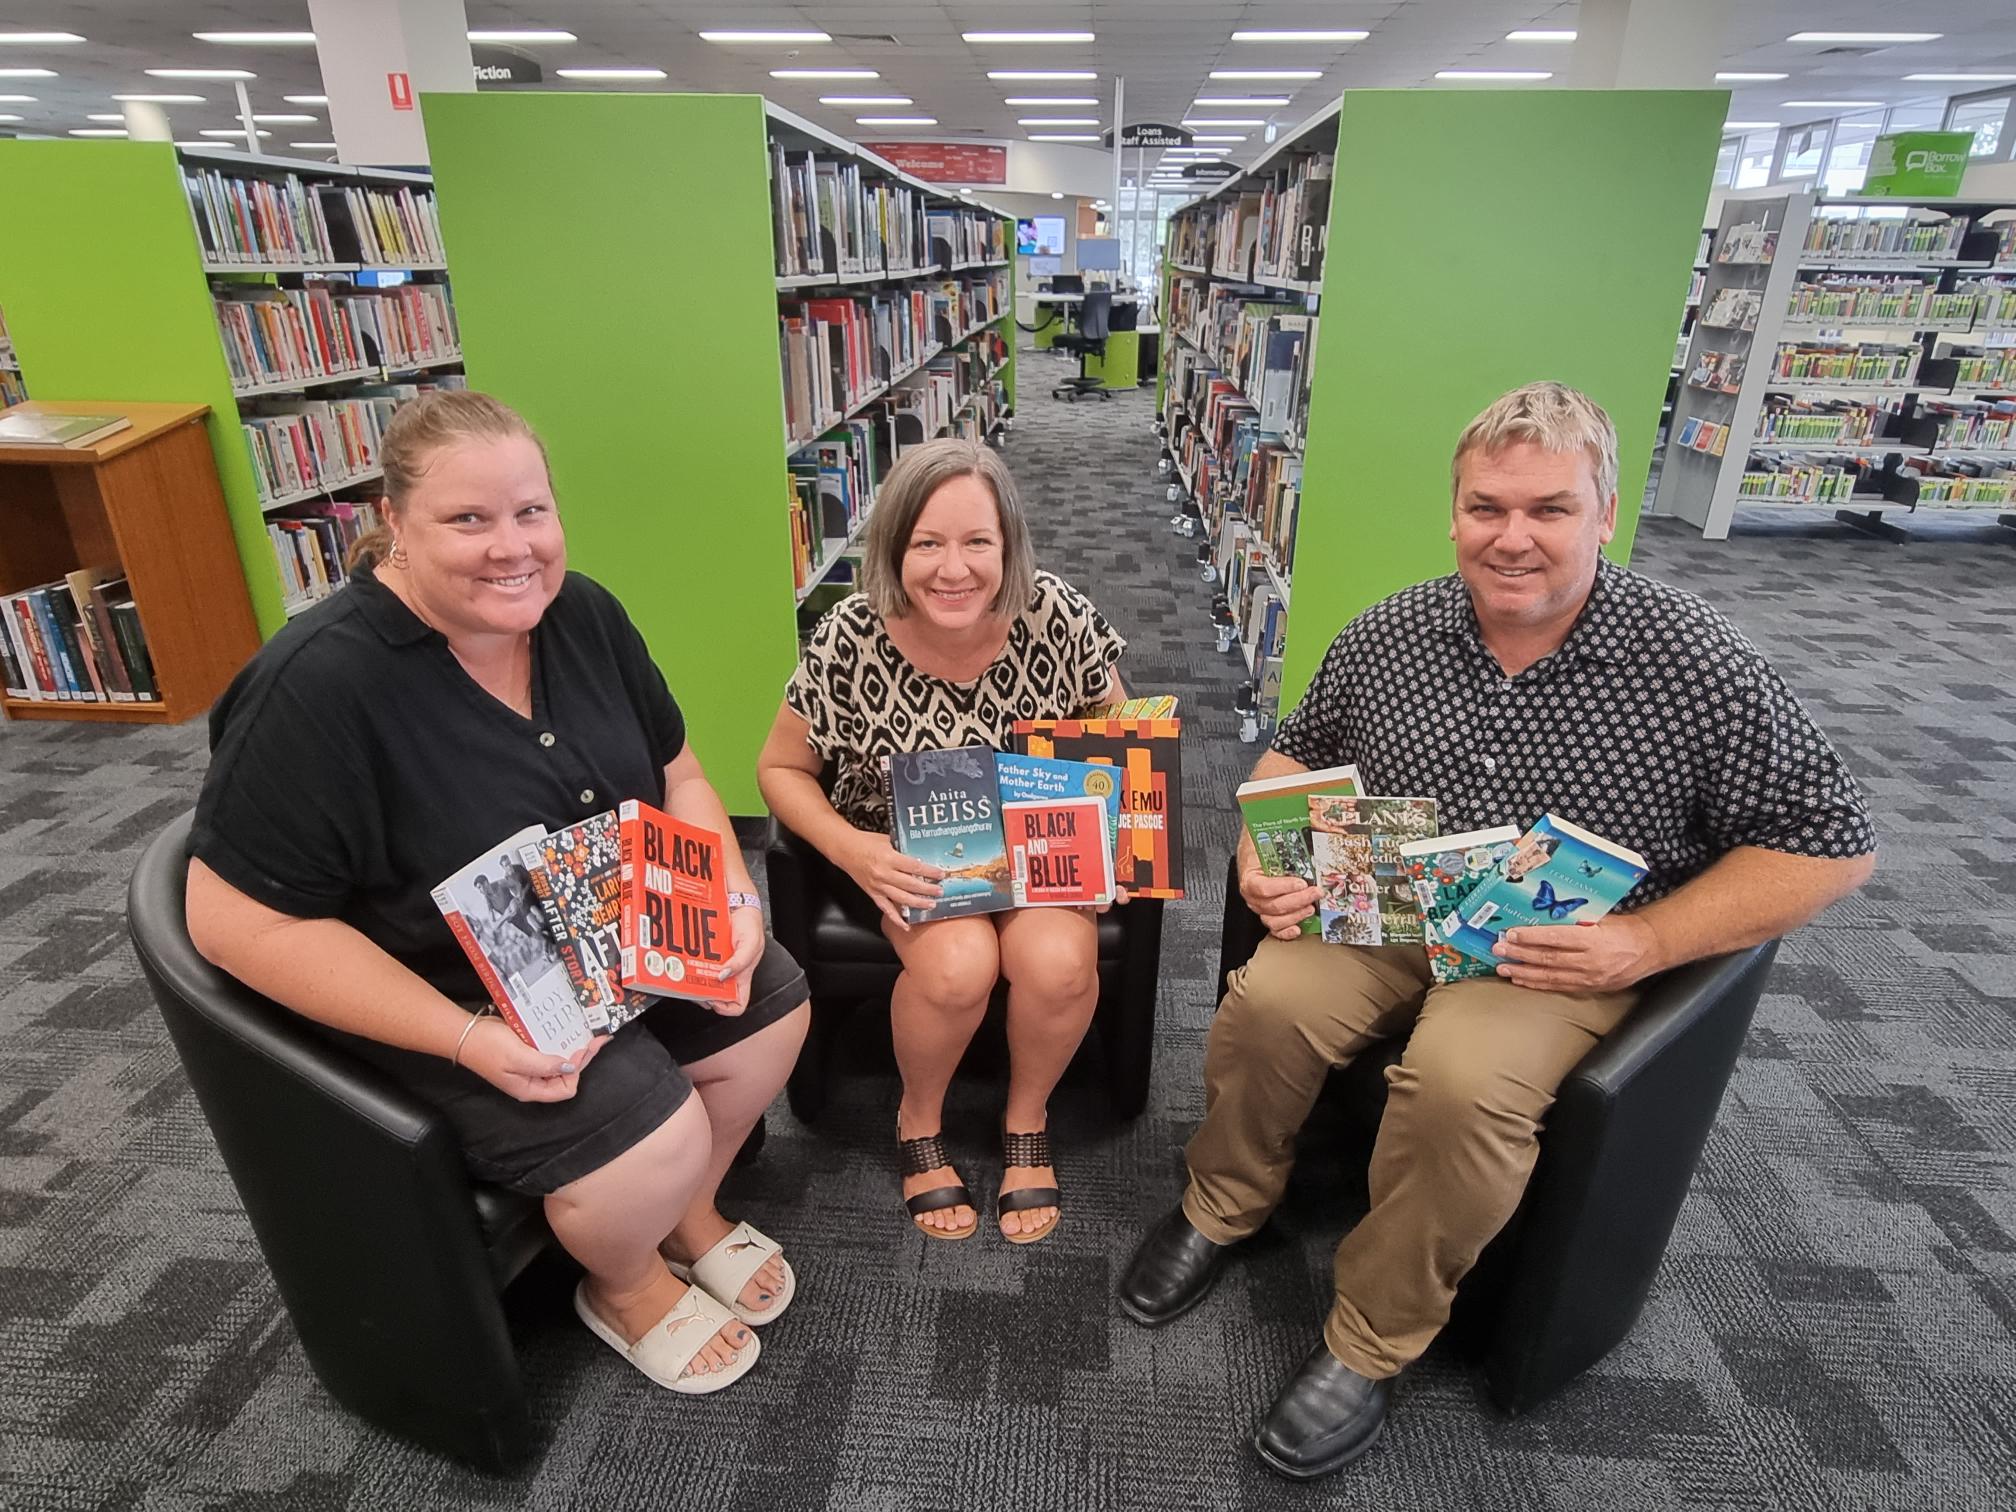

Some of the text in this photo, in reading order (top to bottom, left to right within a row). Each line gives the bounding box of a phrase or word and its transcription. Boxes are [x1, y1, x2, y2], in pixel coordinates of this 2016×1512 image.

[473, 66, 511, 80] Fiction
[1120, 136, 1181, 146] taff Assisted
[1137, 126, 1162, 136] Loans
[895, 159, 944, 169] Welcome
[1928, 151, 1966, 163] Borrow
[998, 763, 1069, 781] Father Sky and
[1000, 775, 1065, 792] Mother Earth
[1093, 780, 1105, 790] 40
[928, 788, 967, 802] Anita
[1131, 790, 1163, 811] EMU
[907, 798, 991, 827] HEISS
[1134, 813, 1163, 830] PASCOE
[1341, 810, 1428, 827] PLANTS
[1024, 812, 1077, 838] BLACK
[644, 820, 713, 881] BLACK
[1027, 838, 1048, 855] AND
[1333, 834, 1402, 848] Bush Tuc
[1357, 852, 1402, 864] Medic
[645, 863, 672, 895] AND
[1029, 854, 1082, 888] BLUE
[594, 875, 621, 902] LARI
[592, 899, 621, 926] BEHR
[1502, 903, 1541, 926] butterfl
[645, 890, 721, 961] BLUE
[542, 899, 586, 986] AFTER STORY
[579, 922, 622, 978] AFT
[532, 991, 563, 1021] BOY
[542, 1004, 575, 1040] BIR
[560, 1030, 581, 1050] BILL
